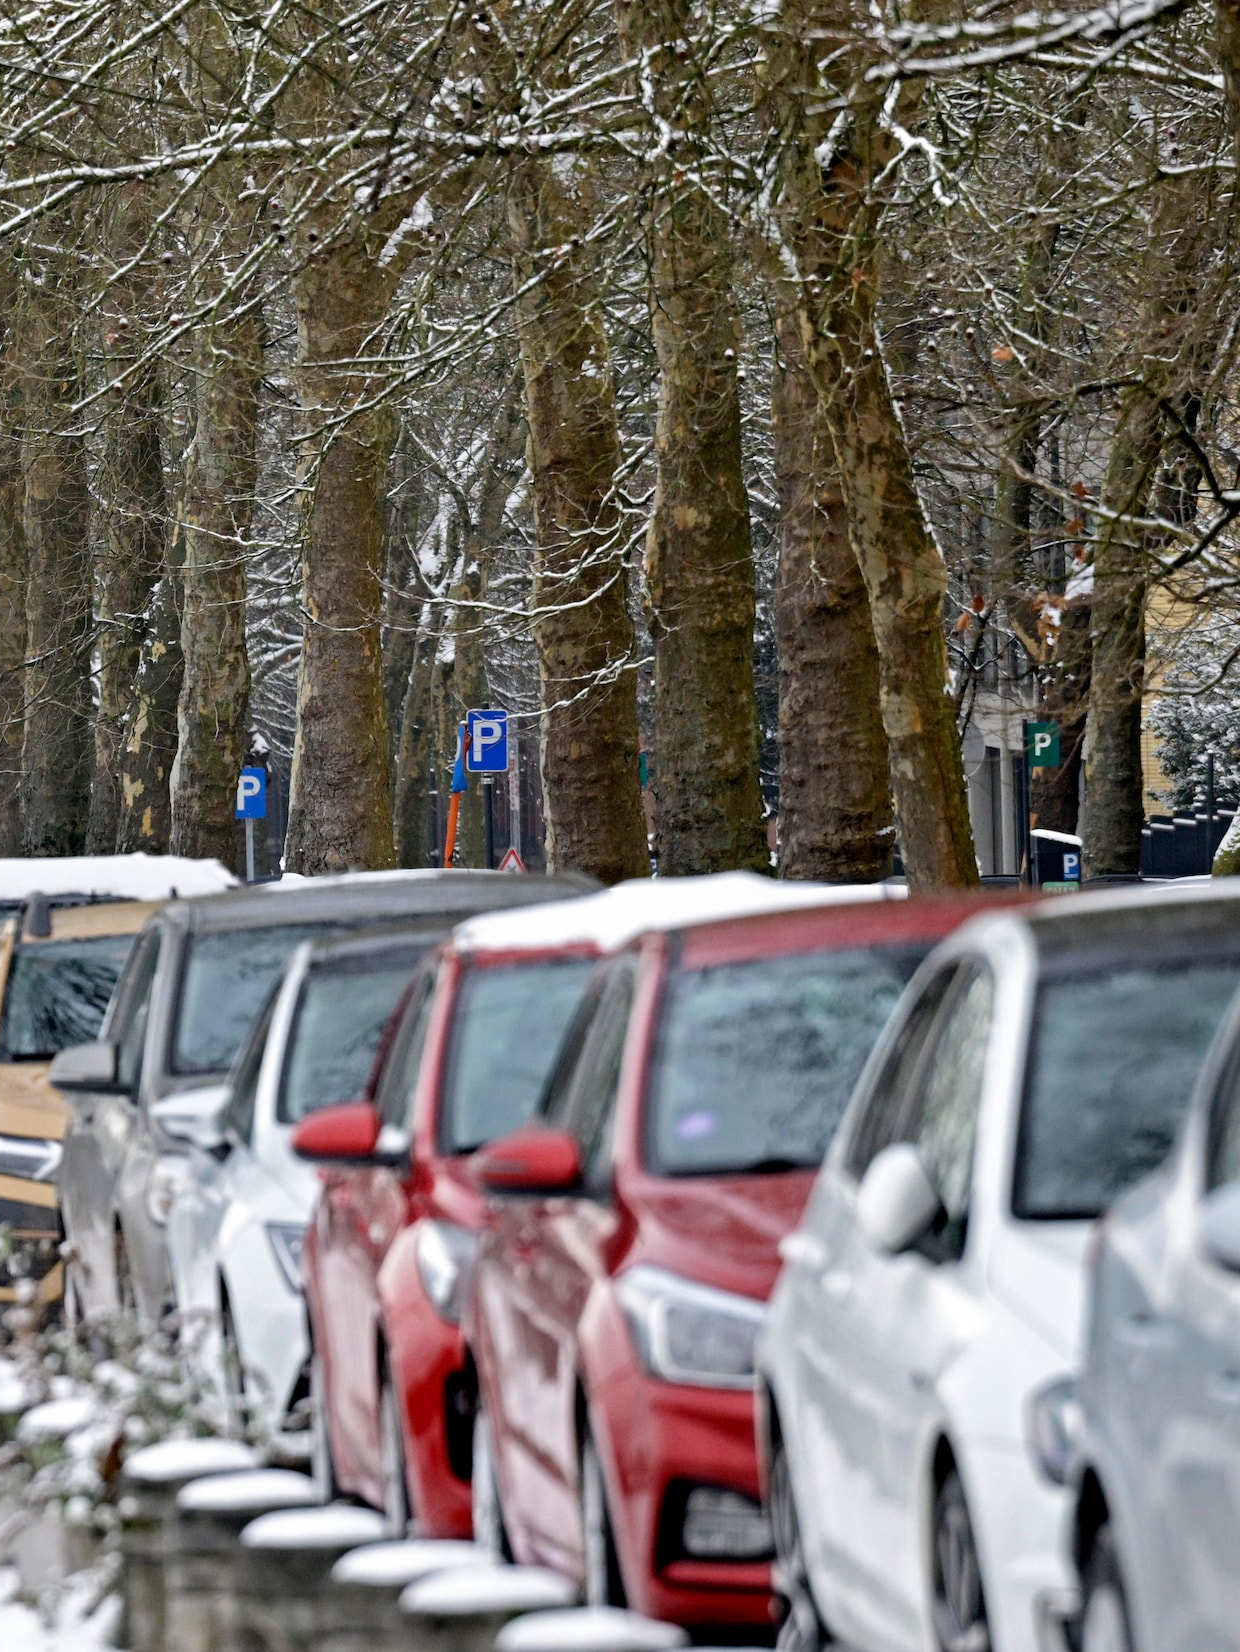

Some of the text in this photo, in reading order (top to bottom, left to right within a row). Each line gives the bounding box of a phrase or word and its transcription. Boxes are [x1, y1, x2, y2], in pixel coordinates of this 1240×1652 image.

[473, 720, 502, 762] P
[1035, 733, 1051, 756] P
[237, 775, 260, 811] P
[1063, 854, 1078, 873] P
